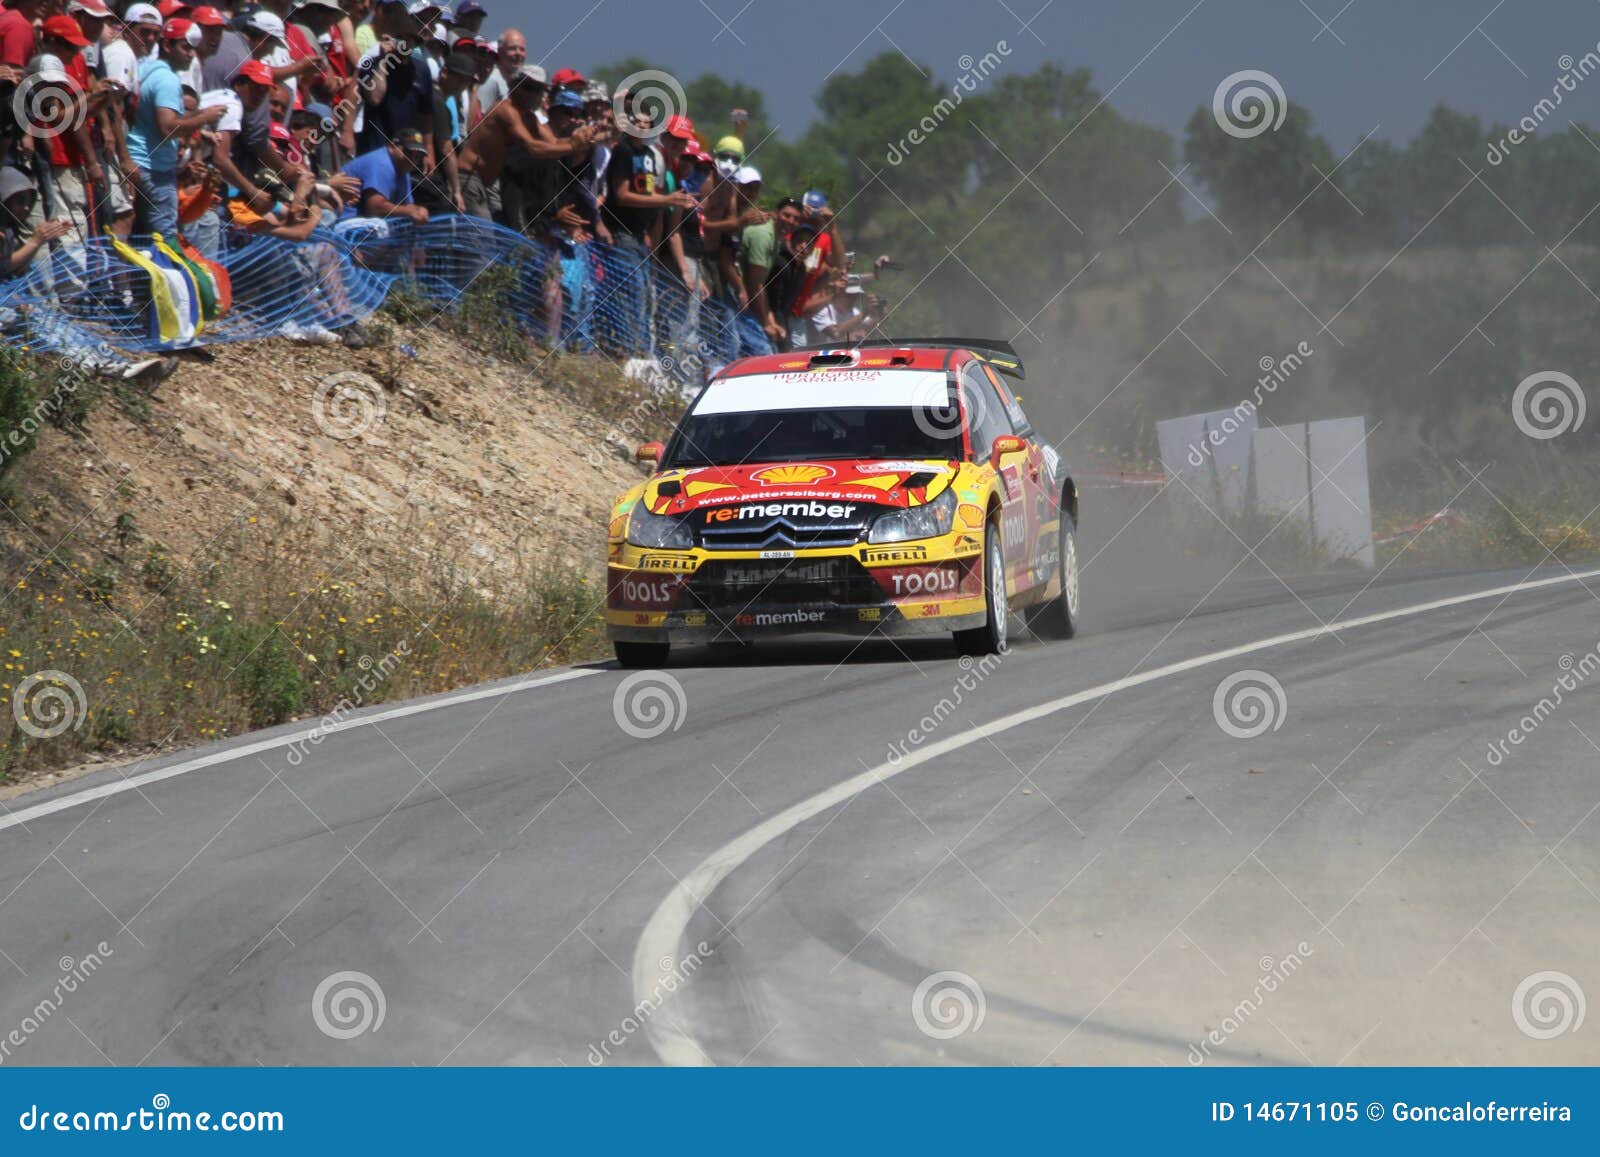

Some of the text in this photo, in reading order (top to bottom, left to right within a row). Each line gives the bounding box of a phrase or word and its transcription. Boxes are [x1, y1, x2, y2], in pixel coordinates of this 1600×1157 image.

[705, 500, 856, 524] re:member
[638, 552, 699, 571] PIRELLI
[859, 545, 928, 563] PIRELLI
[622, 579, 671, 602] TOOLS
[892, 569, 956, 595] TOOLS
[634, 613, 650, 625] 3M
[922, 603, 940, 616] 3M
